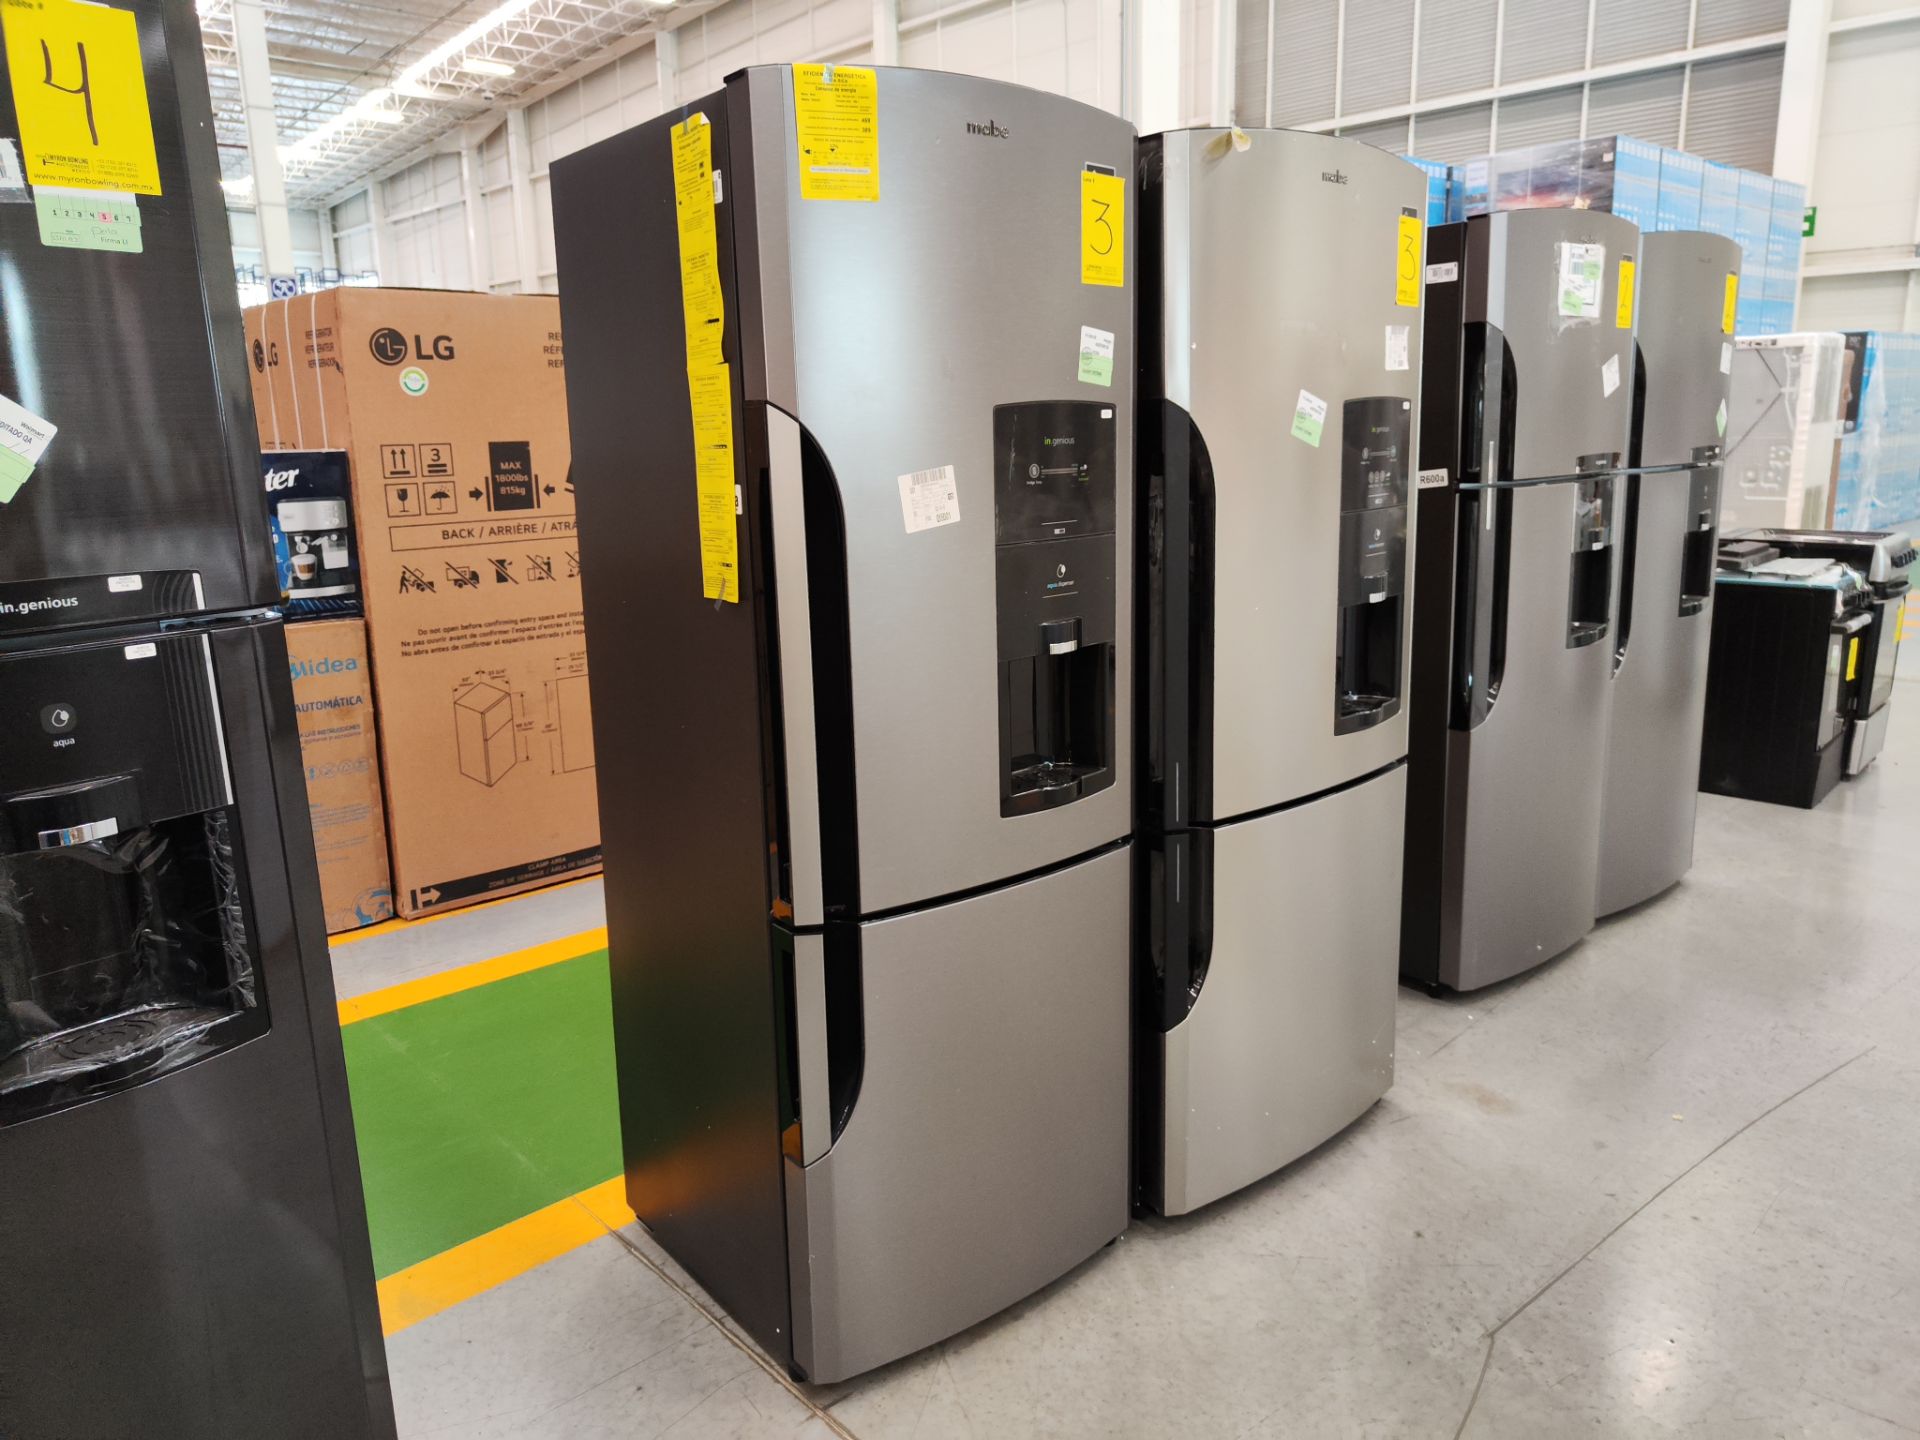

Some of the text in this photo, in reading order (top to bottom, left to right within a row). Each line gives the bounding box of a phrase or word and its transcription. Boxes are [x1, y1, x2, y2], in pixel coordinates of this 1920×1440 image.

[40, 39, 98, 145] 4
[966, 119, 1010, 140] mabe
[33, 172, 154, 191] www.myronbowling.com.mx
[1090, 198, 1113, 256] 3
[1400, 233, 1416, 281] 3
[415, 335, 455, 361] LG
[22, 434, 33, 445] QA
[430, 448, 441, 462] 3
[500, 461, 521, 470] MAX
[495, 473, 528, 483] 1800lbs
[1419, 475, 1446, 485] R600a
[442, 528, 475, 541] BACK
[488, 522, 538, 537] ARRIÈRE
[0, 597, 79, 614] in.genious
[461, 622, 482, 631] before
[53, 737, 75, 748] aqua
